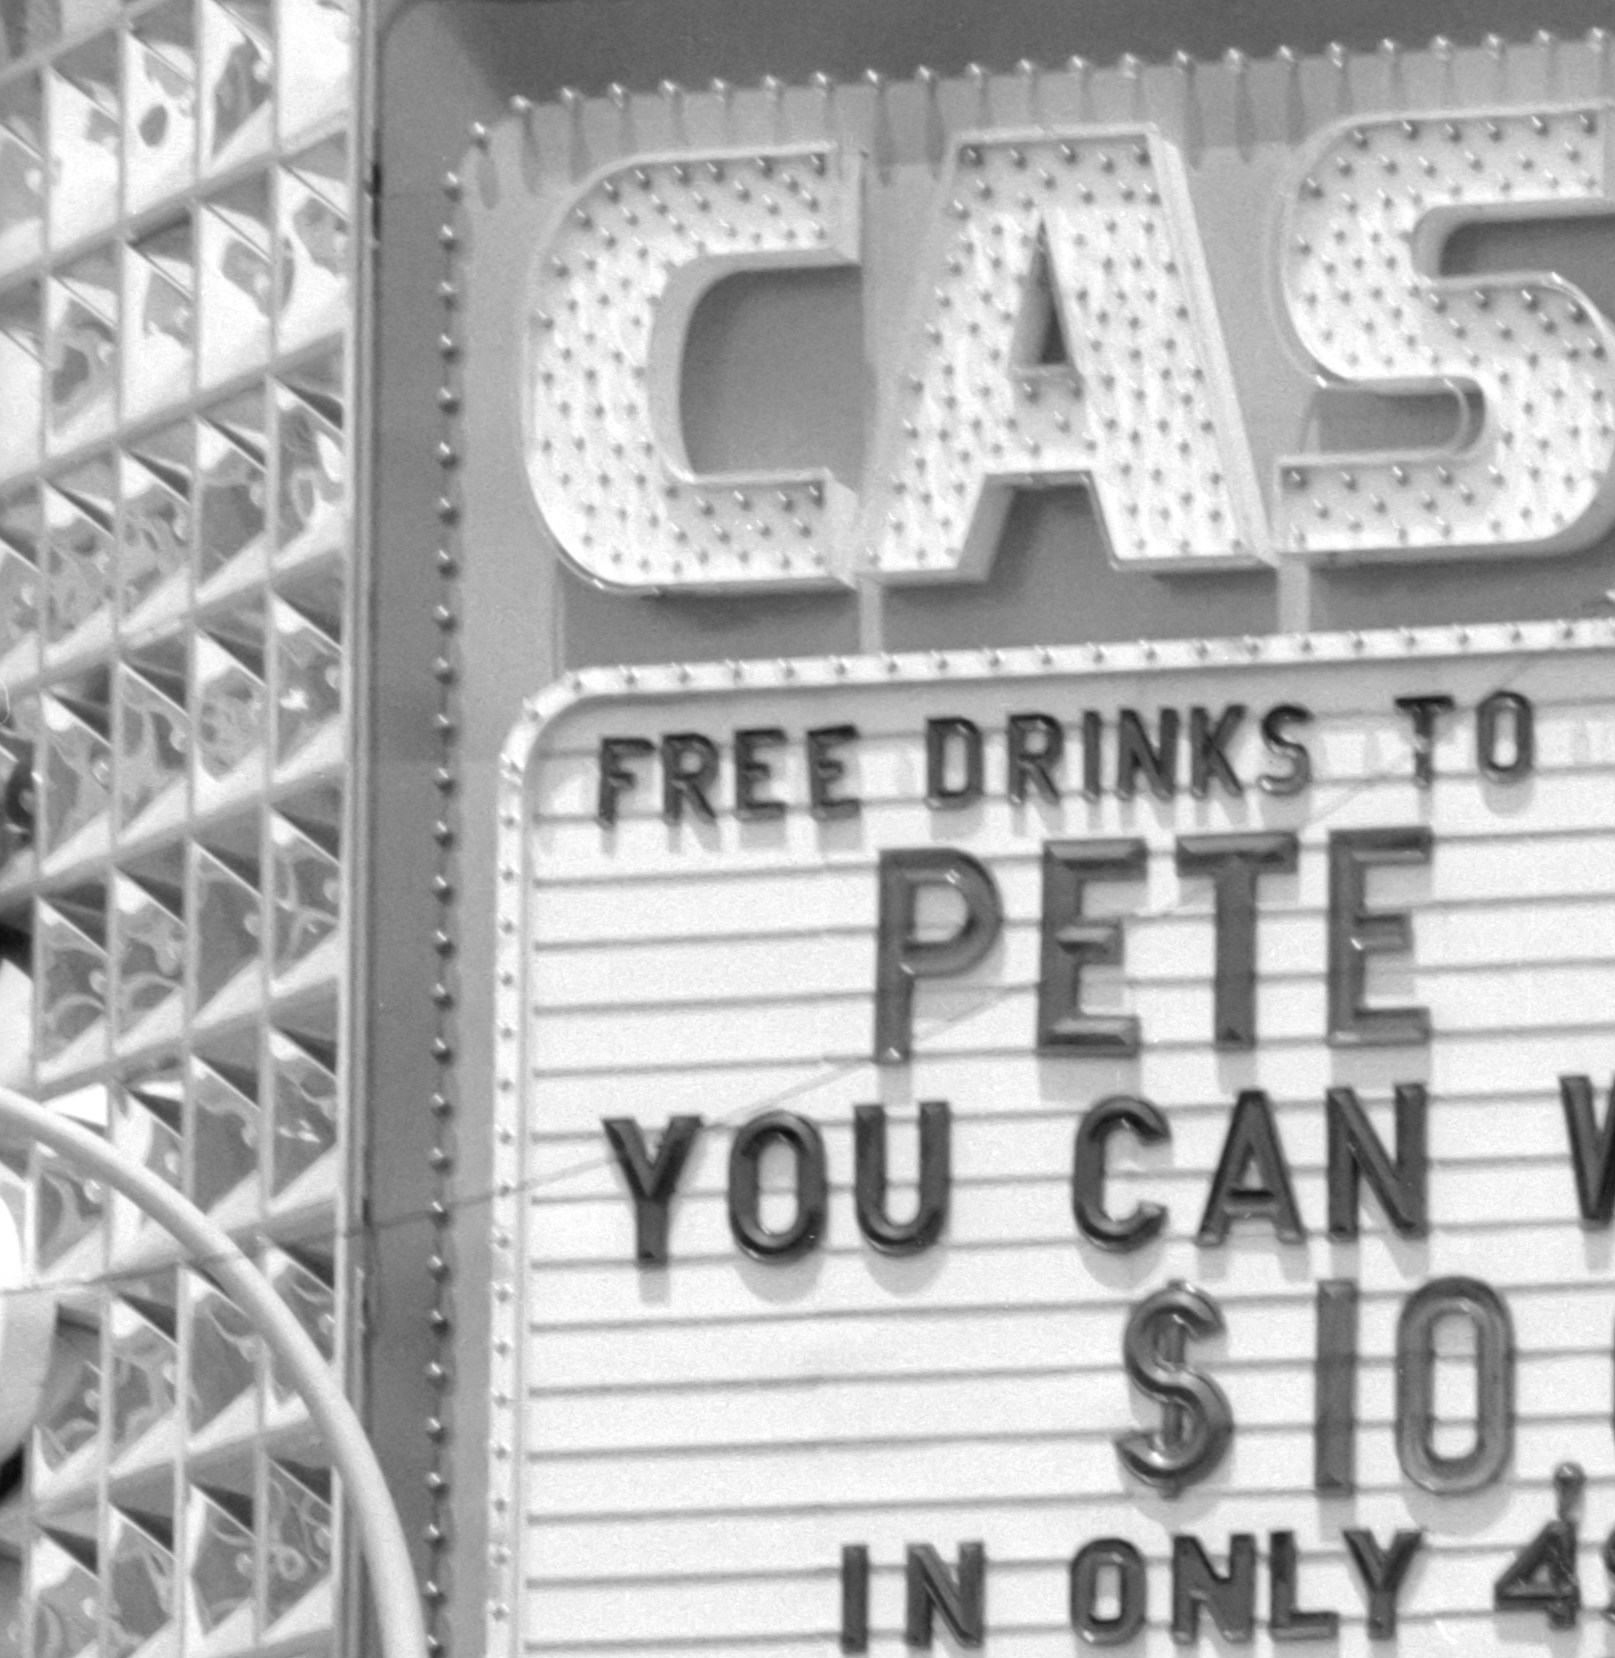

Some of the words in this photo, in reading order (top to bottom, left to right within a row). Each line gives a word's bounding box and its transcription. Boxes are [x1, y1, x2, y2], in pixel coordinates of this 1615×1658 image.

[595, 721, 864, 828] FREE
[922, 701, 1317, 812] DRINKS
[1391, 686, 1537, 787] TO
[871, 825, 1438, 1068] PETE
[601, 1099, 955, 1272] YOU
[1069, 1080, 1432, 1258] CAN
[837, 1541, 990, 1657] IN
[1066, 1527, 1427, 1650] ONLY
